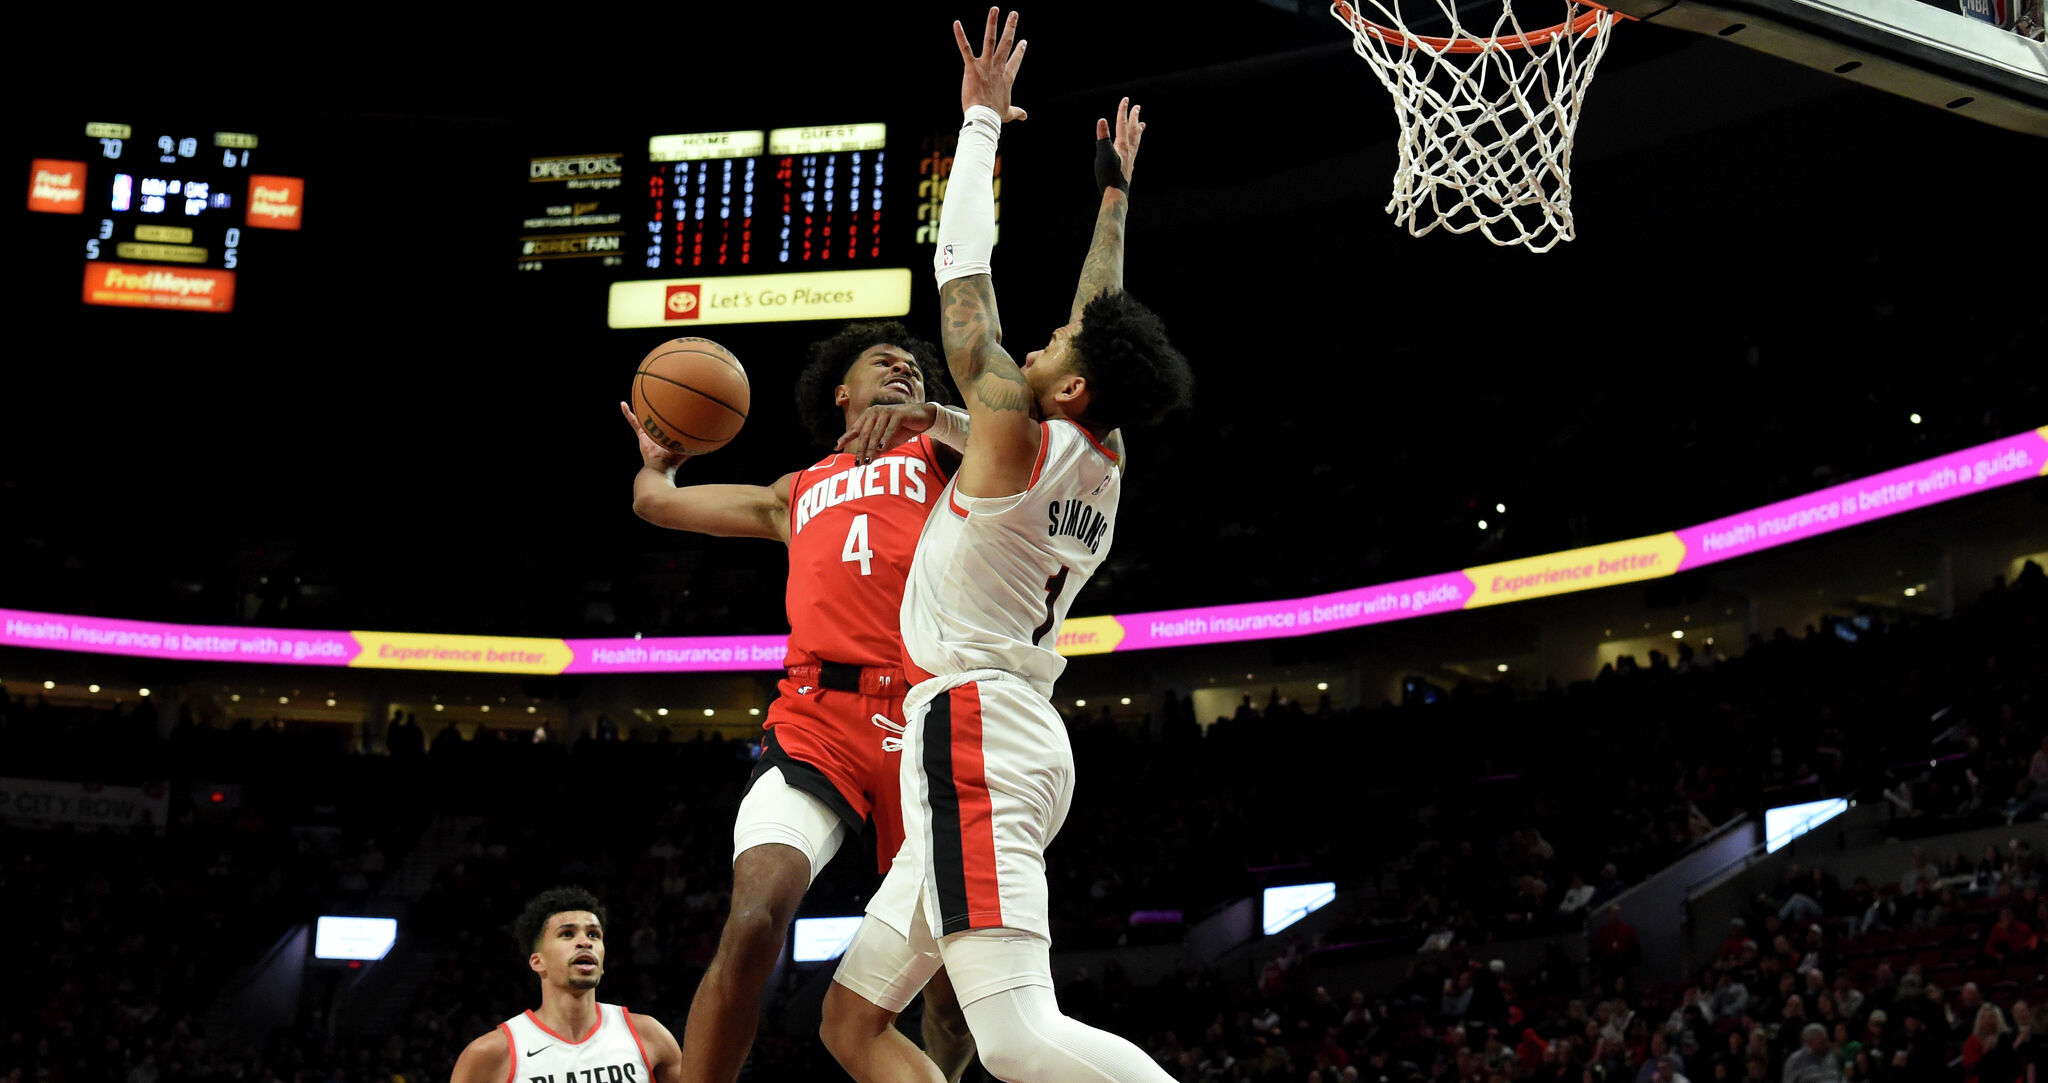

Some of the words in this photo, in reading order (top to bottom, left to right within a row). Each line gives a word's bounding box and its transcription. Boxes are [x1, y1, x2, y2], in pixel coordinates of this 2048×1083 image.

[1967, 0, 1990, 16] NBA
[35, 169, 72, 187] Fred
[32, 184, 81, 203] Meyer
[253, 186, 290, 203] Fred
[250, 202, 299, 218] Meyer
[711, 291, 752, 309] Let's
[759, 289, 788, 306] Go
[792, 288, 855, 305] Places
[796, 456, 927, 536] ROCKETS
[1703, 523, 1757, 553] Health
[1758, 502, 1840, 537] insurance
[1842, 494, 1858, 516] is
[1859, 480, 1917, 511] better
[1918, 466, 1957, 494] with
[1958, 464, 1972, 484] a
[1973, 448, 2033, 485] guide.
[1048, 498, 1108, 555] SIMONS
[842, 513, 874, 576] 4
[1491, 563, 1595, 594] Experience
[1597, 551, 1662, 577] better.
[1032, 564, 1070, 647] 1
[1150, 617, 1208, 639] Health
[1210, 611, 1295, 633] insurance
[1298, 608, 1312, 626] is
[1314, 600, 1362, 624] better
[1363, 593, 1399, 616] with
[1400, 594, 1411, 609] a
[1412, 582, 1463, 611] guide.
[6, 618, 69, 641] Health
[70, 623, 162, 650] insurance
[163, 631, 180, 650] is
[182, 633, 238, 652] better
[239, 636, 278, 655] with
[279, 641, 293, 656] a
[293, 638, 348, 660] guide.
[1056, 628, 1100, 648] etter.
[378, 643, 483, 665] Experience
[486, 645, 549, 666] better.
[592, 645, 648, 665] Health
[650, 645, 732, 664] insurance
[734, 644, 749, 662] is
[751, 643, 788, 662] bett
